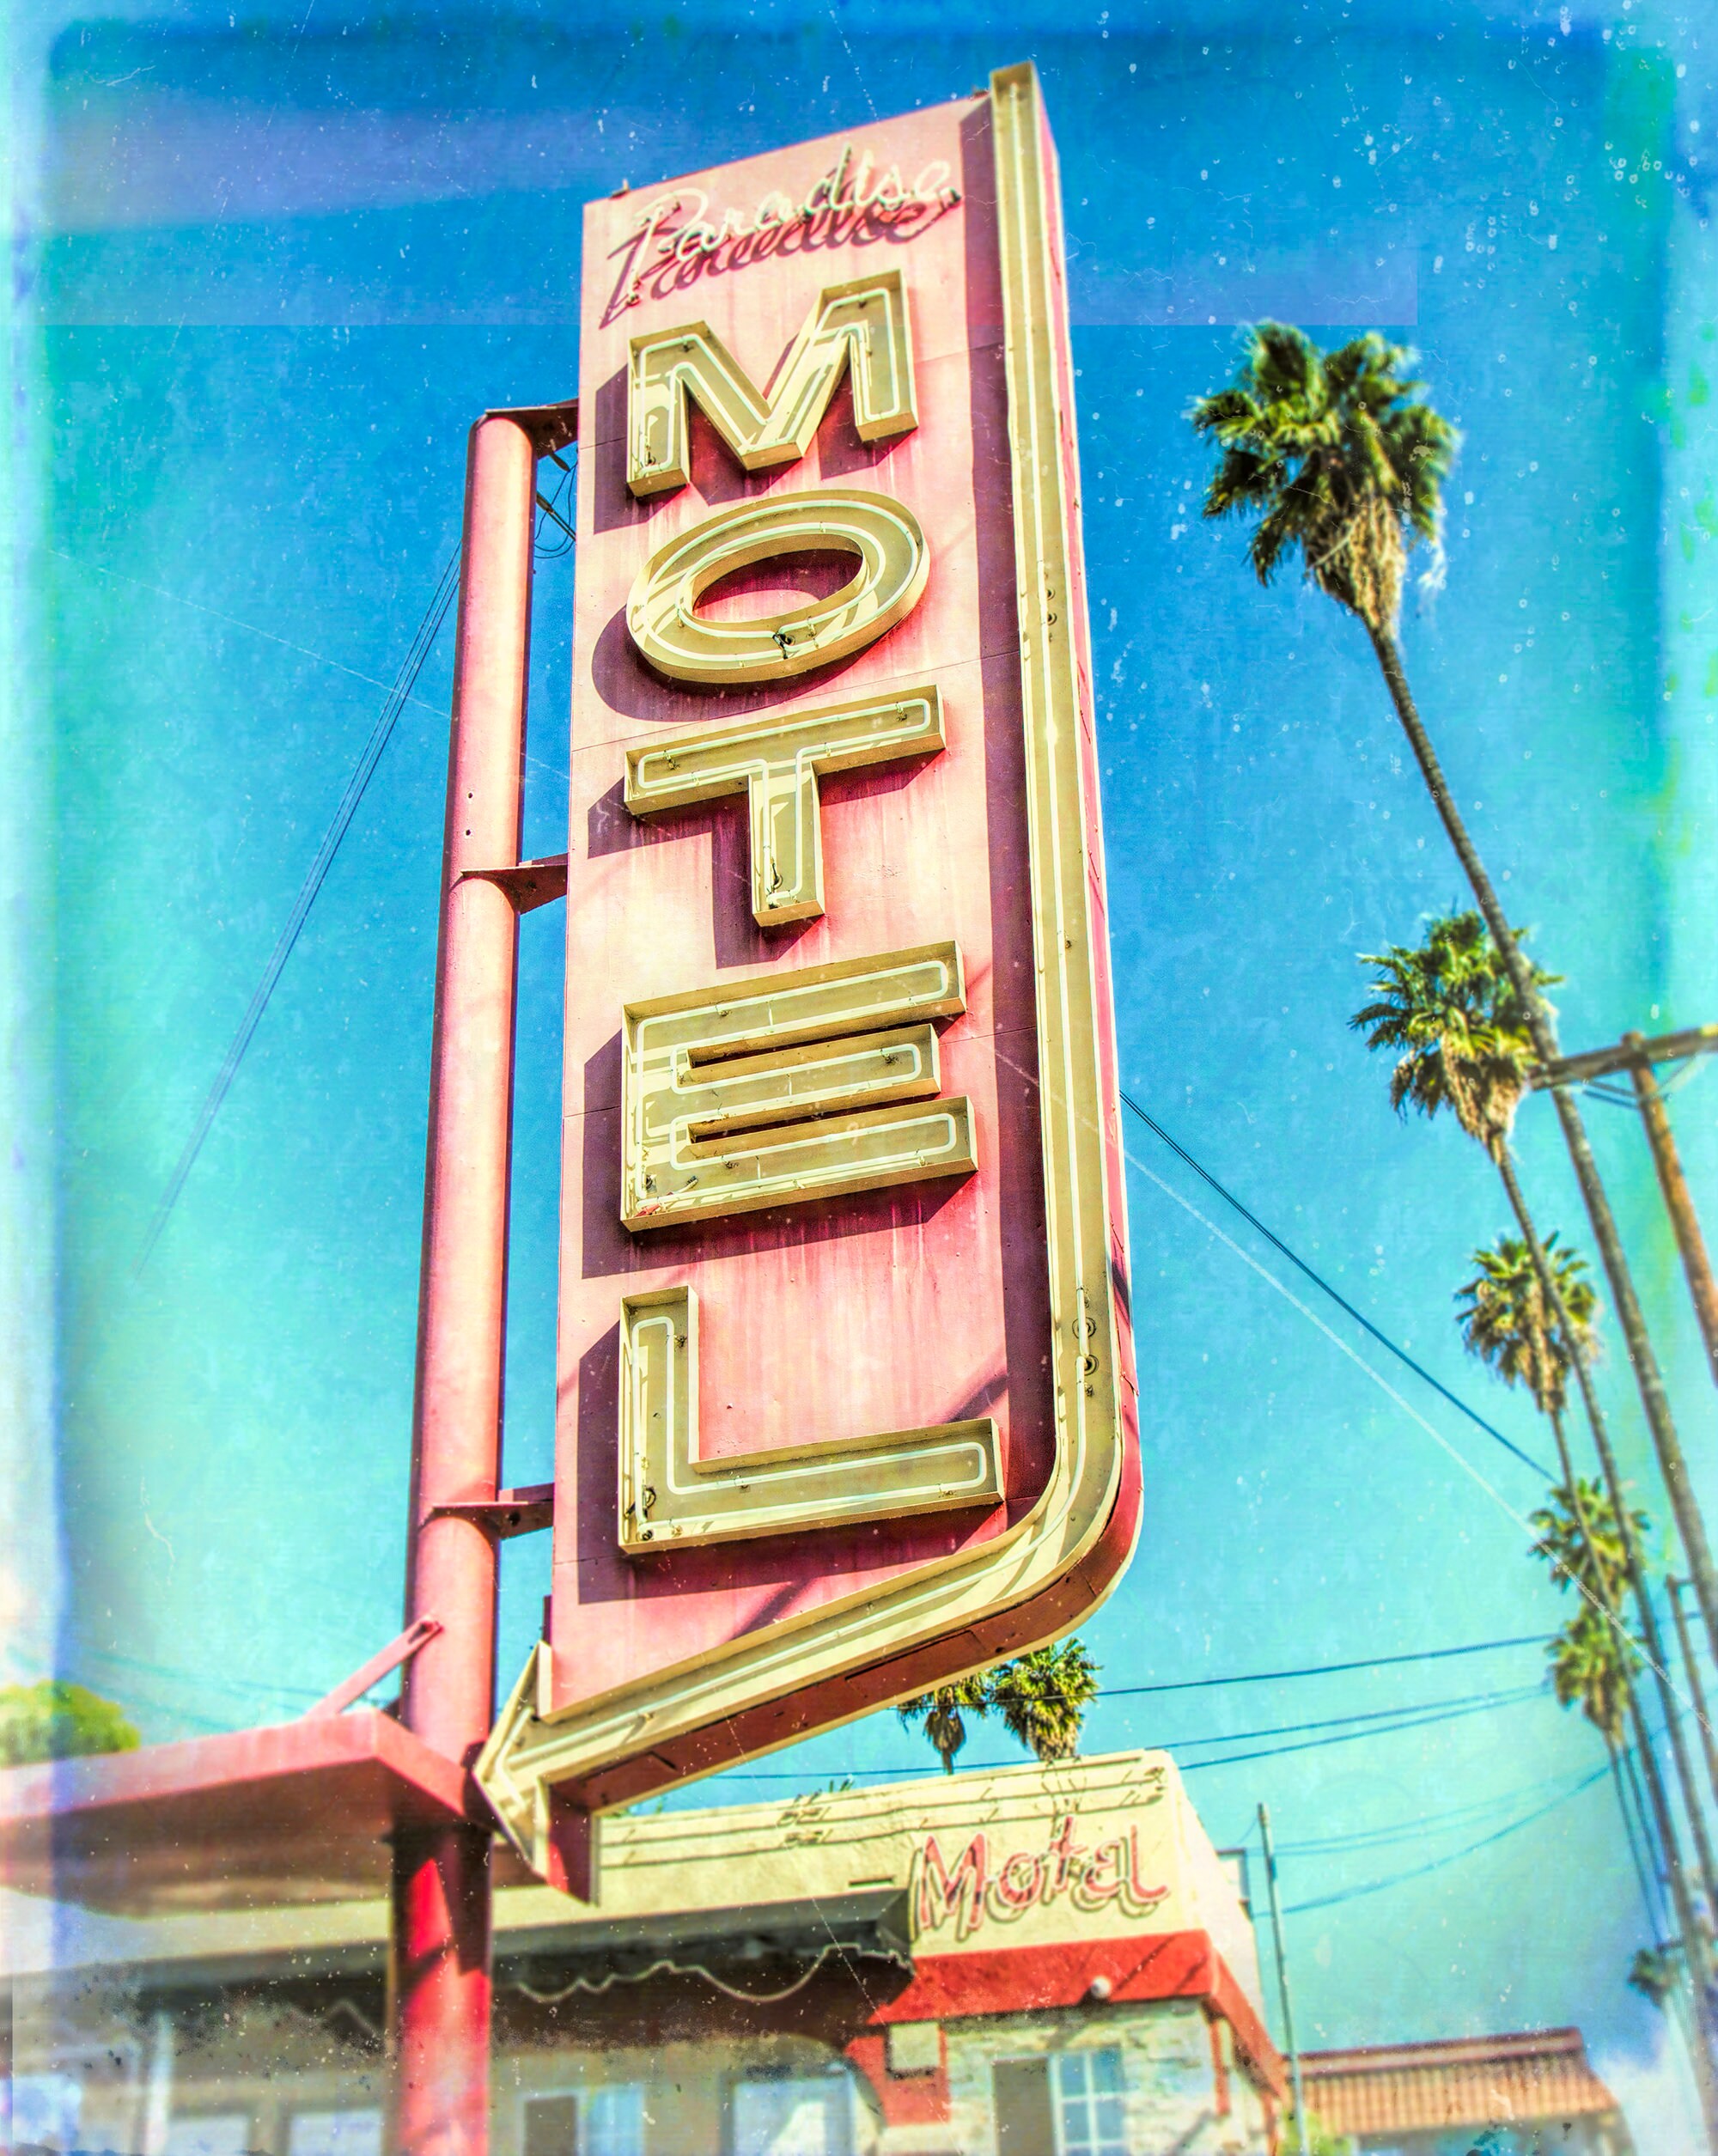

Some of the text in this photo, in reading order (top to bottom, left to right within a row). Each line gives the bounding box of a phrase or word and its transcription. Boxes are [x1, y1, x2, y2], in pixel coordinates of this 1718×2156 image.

[625, 143, 961, 307] Paradise
[618, 268, 1005, 1556] MOTEL
[918, 1816, 1169, 1931] Motel
